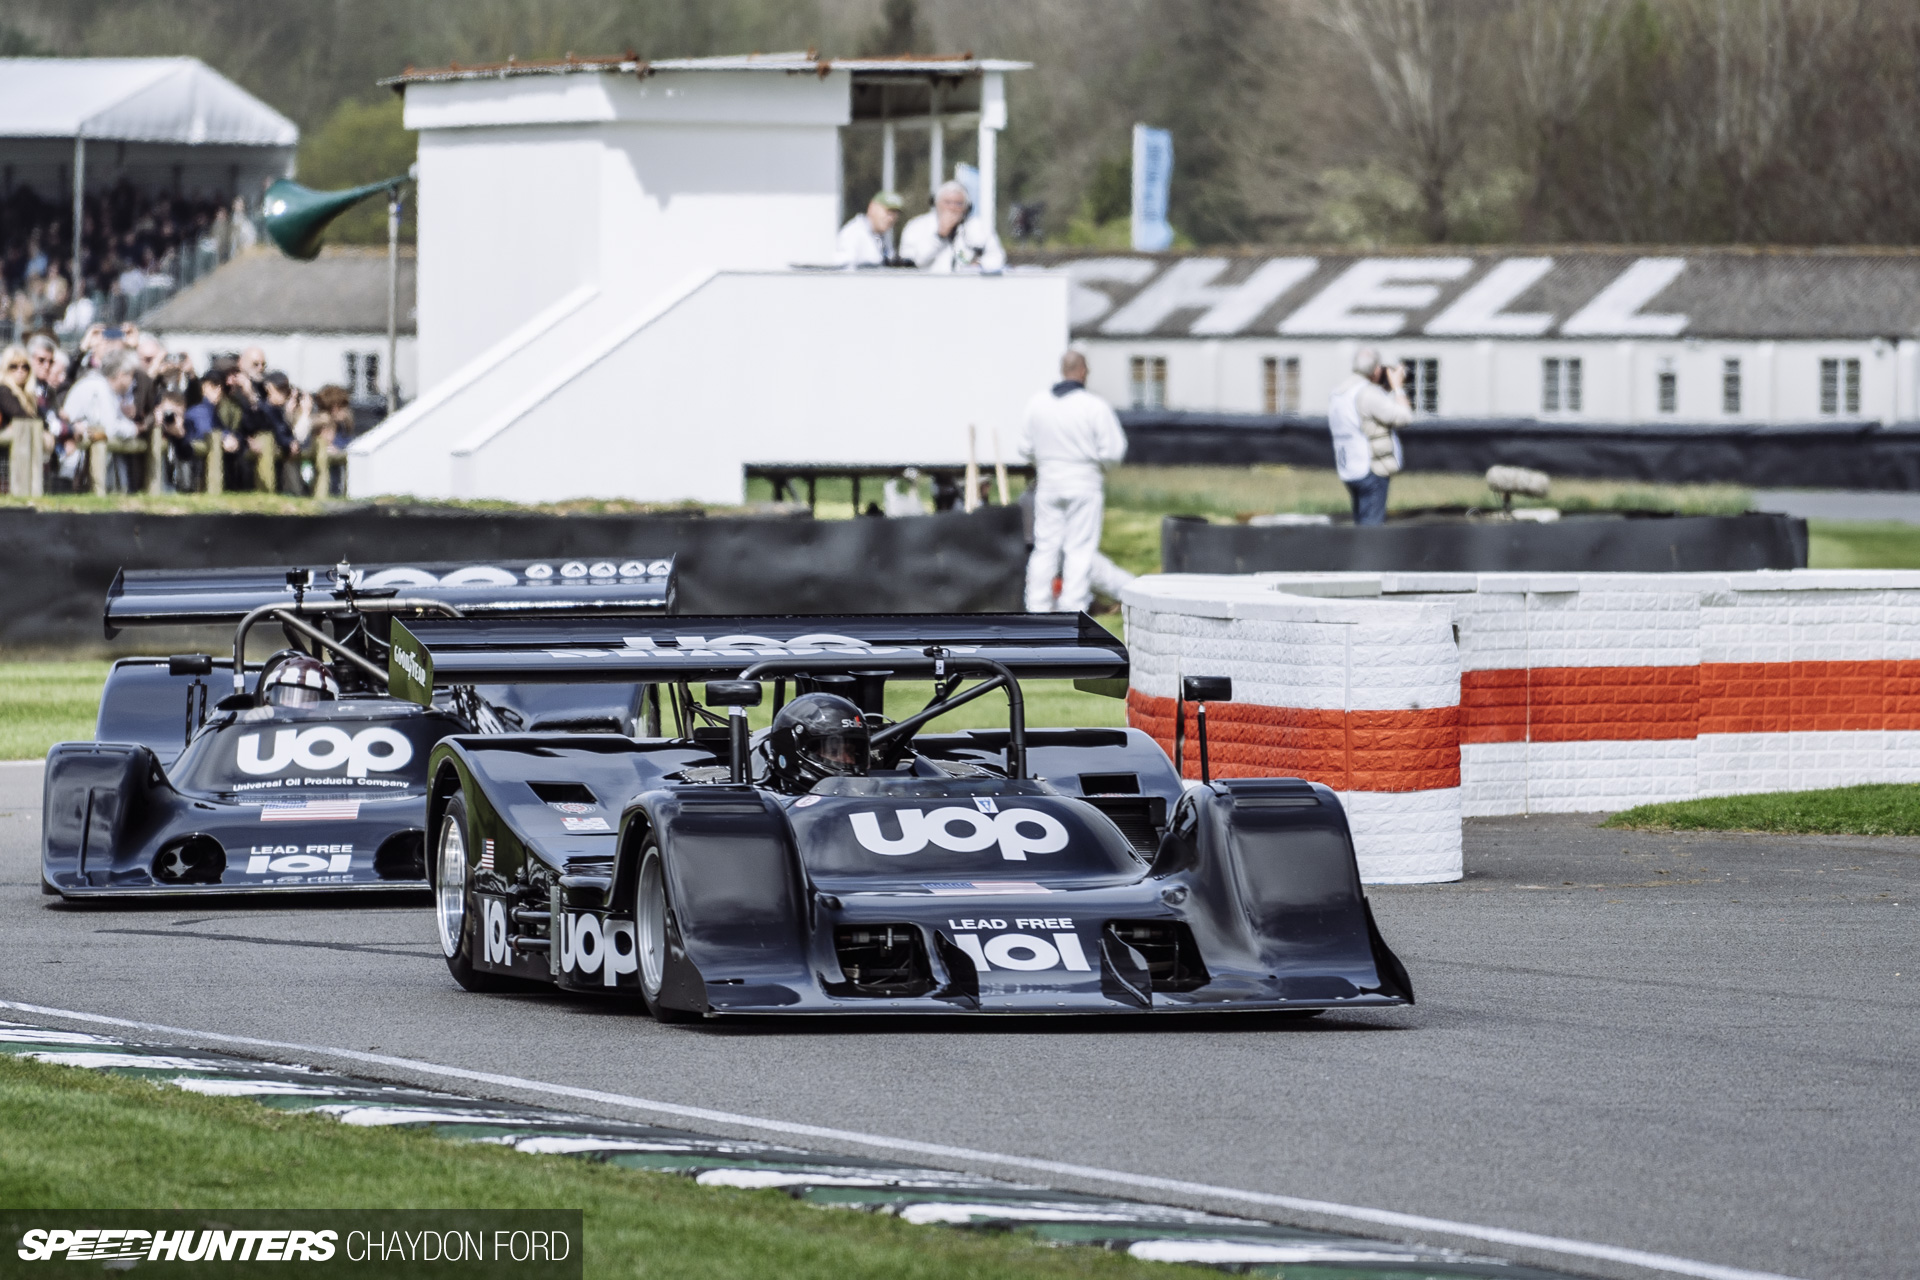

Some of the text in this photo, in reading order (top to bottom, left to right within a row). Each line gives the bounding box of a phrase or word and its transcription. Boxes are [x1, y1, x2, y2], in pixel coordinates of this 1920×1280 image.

[1067, 256, 1690, 336] SHELL
[232, 776, 410, 792] Universal Oil Products Company
[250, 844, 353, 855] LEAD FREE
[246, 854, 352, 874] 101
[948, 917, 1076, 930] LEAD FREE
[953, 932, 1092, 972] 101
